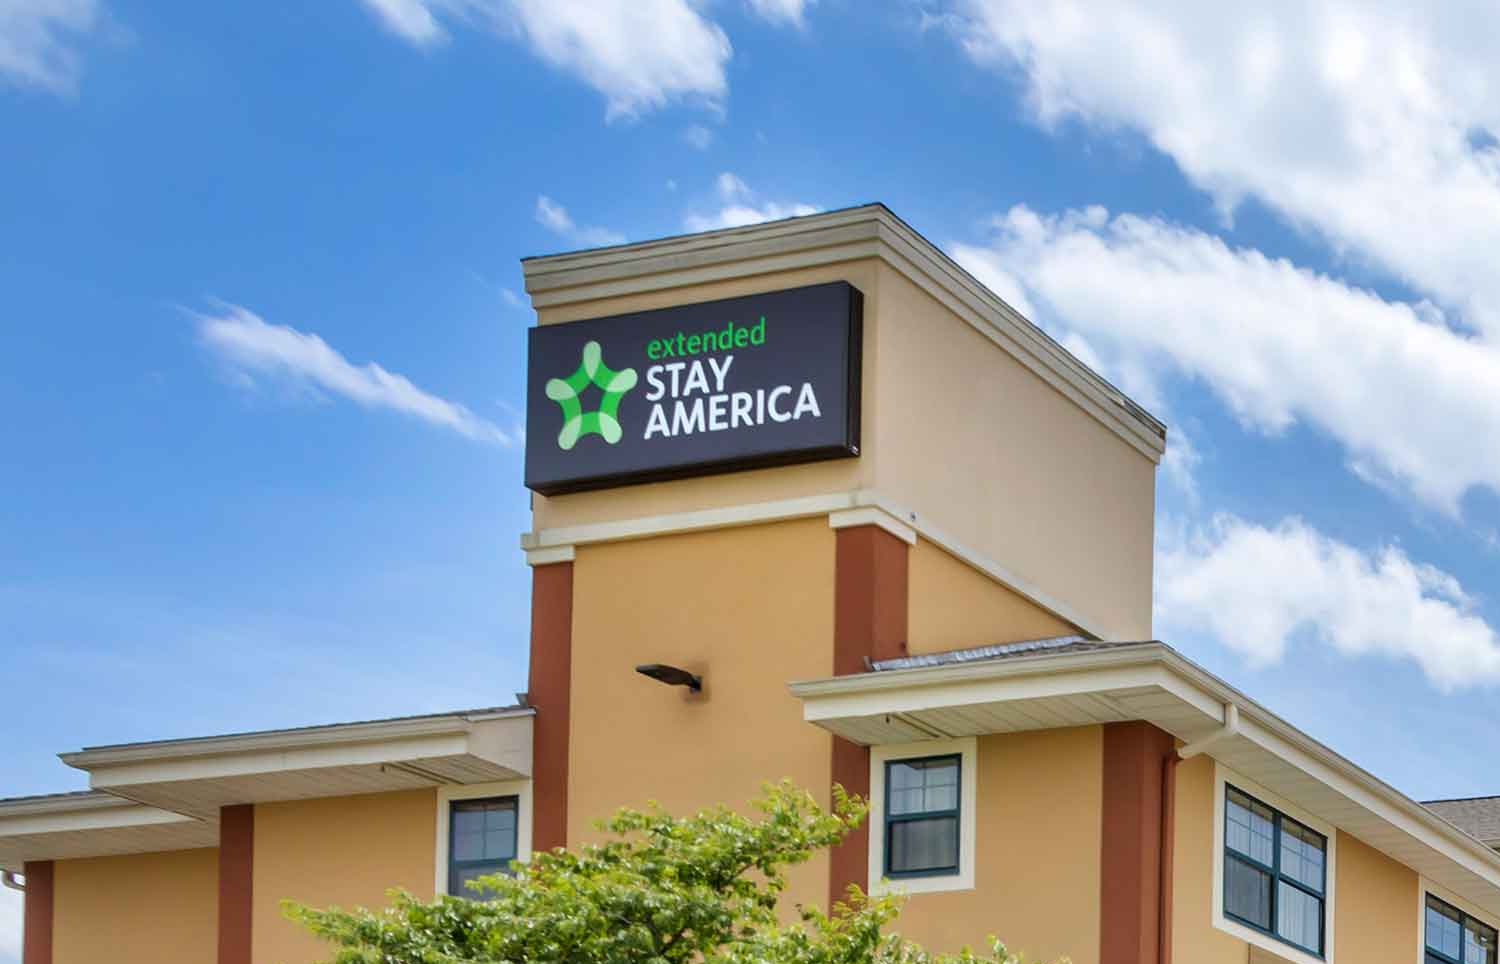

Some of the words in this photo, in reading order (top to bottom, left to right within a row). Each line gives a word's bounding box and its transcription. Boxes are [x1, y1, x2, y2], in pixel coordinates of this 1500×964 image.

[647, 316, 766, 360] extended
[645, 355, 734, 402] STAY
[643, 382, 822, 440] AMERICA
